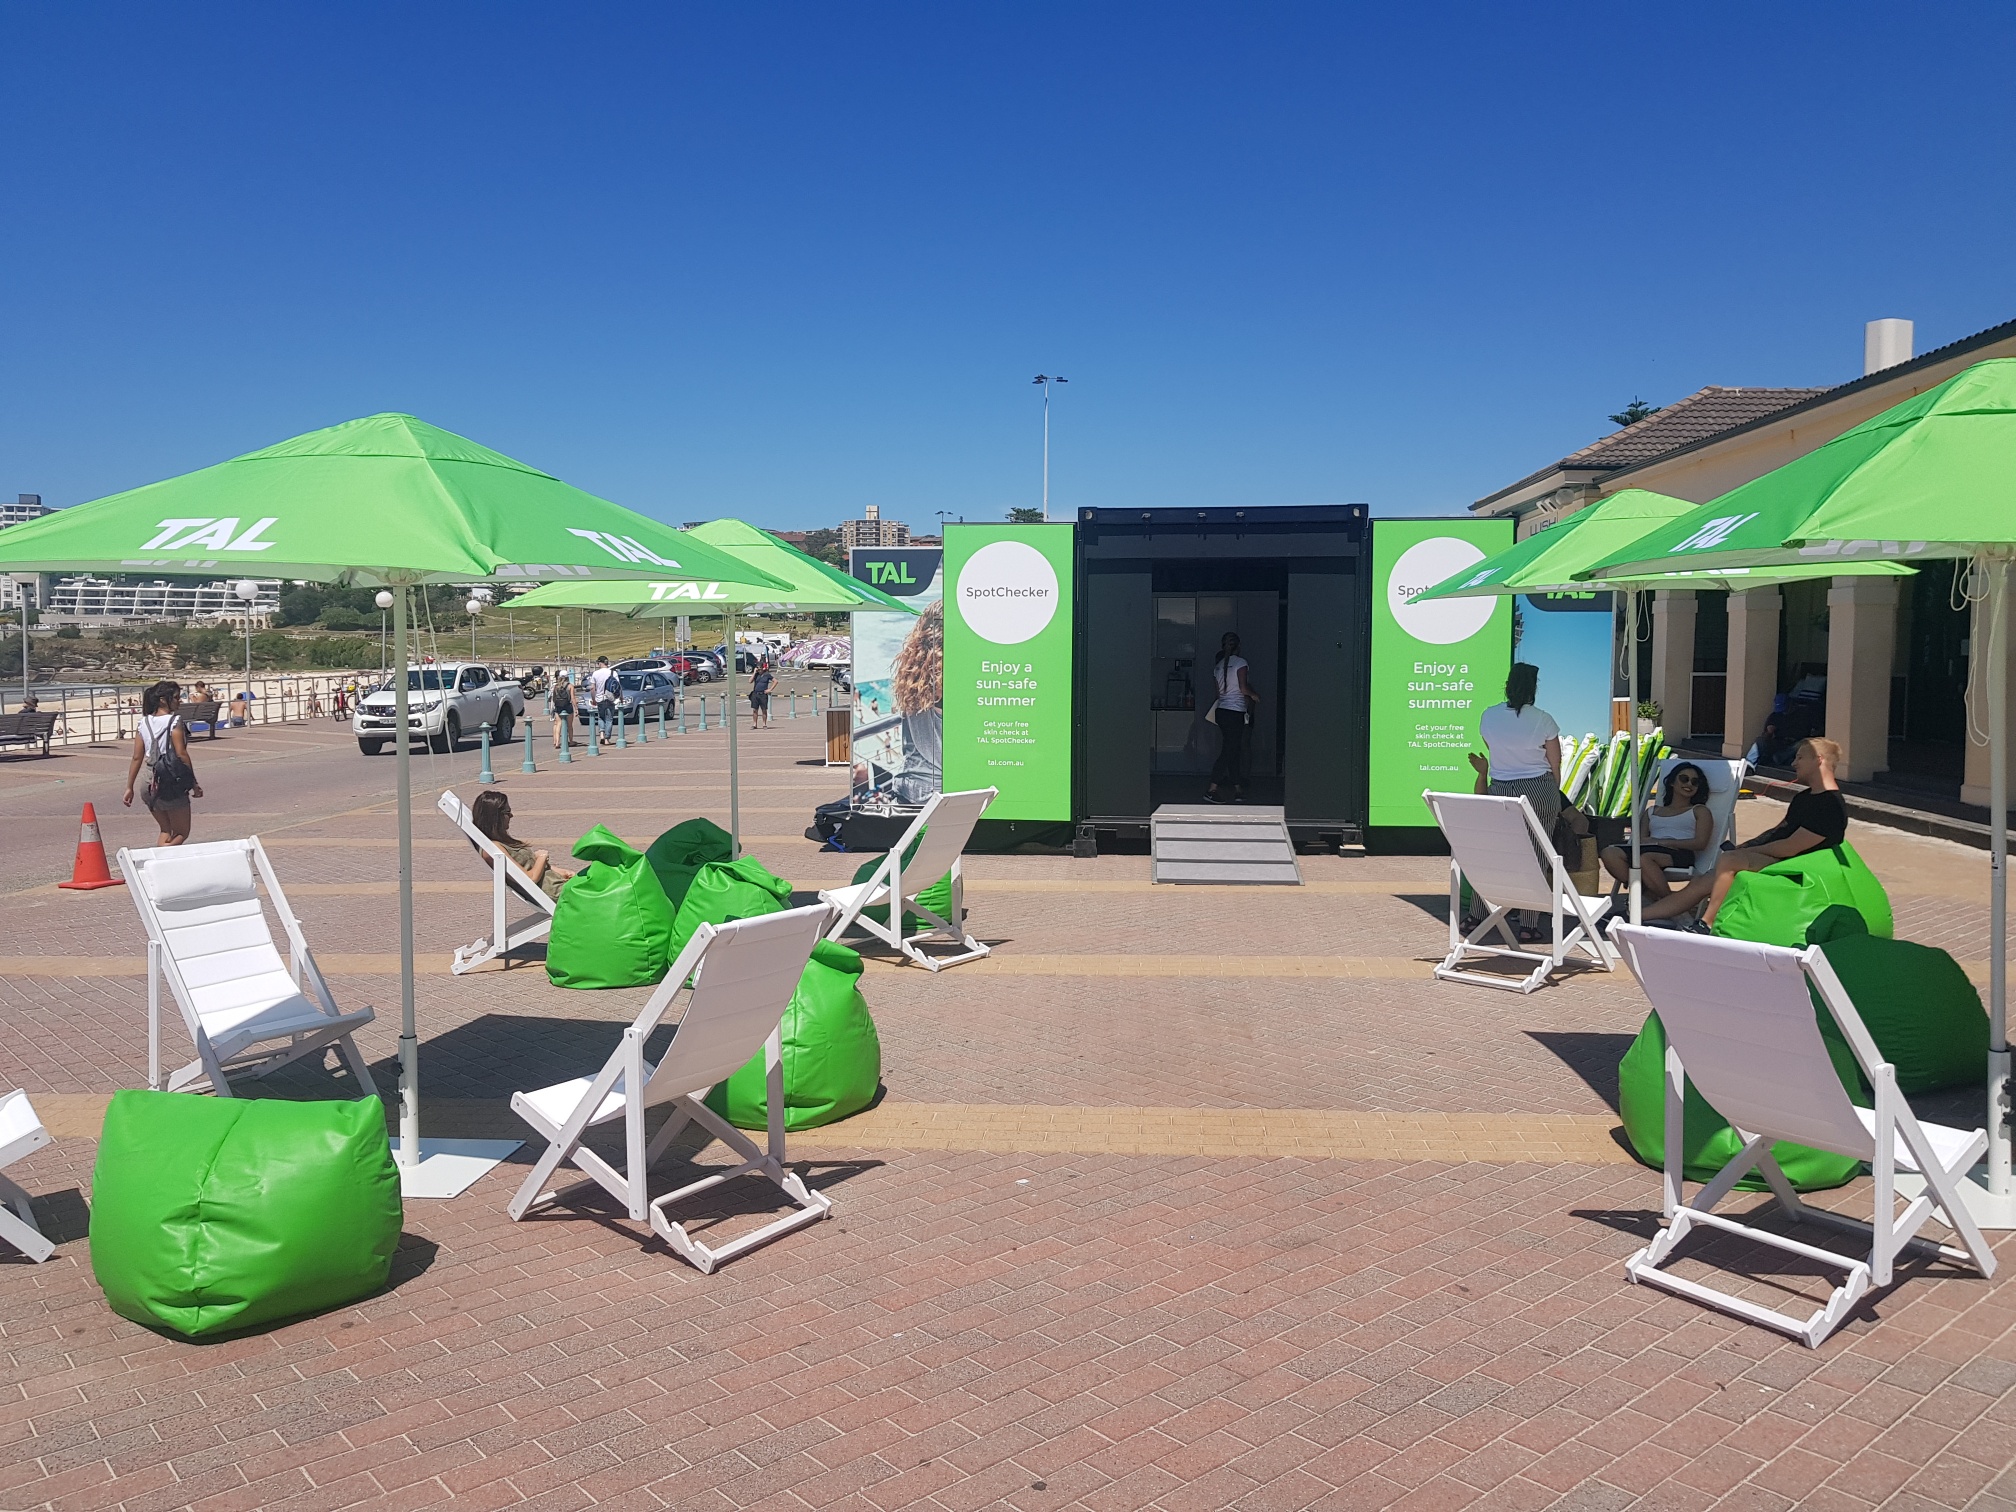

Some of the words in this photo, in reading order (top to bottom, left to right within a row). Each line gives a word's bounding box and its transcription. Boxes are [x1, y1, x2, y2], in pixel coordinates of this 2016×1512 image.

[138, 517, 280, 551] TAL
[564, 527, 683, 569] TAL
[865, 561, 917, 584] TAL
[647, 582, 730, 601] TAL
[965, 586, 1050, 600] SpotChecker
[981, 660, 1021, 675] Enjoy
[1024, 663, 1033, 673] a
[1413, 661, 1456, 676] Enjoy
[1459, 664, 1469, 674] a
[976, 677, 1038, 690] sun-safe
[1407, 678, 1474, 691] sun-safe
[977, 696, 1036, 706] summer
[1408, 698, 1473, 709] summer
[990, 737, 1036, 745] SpotChecker
